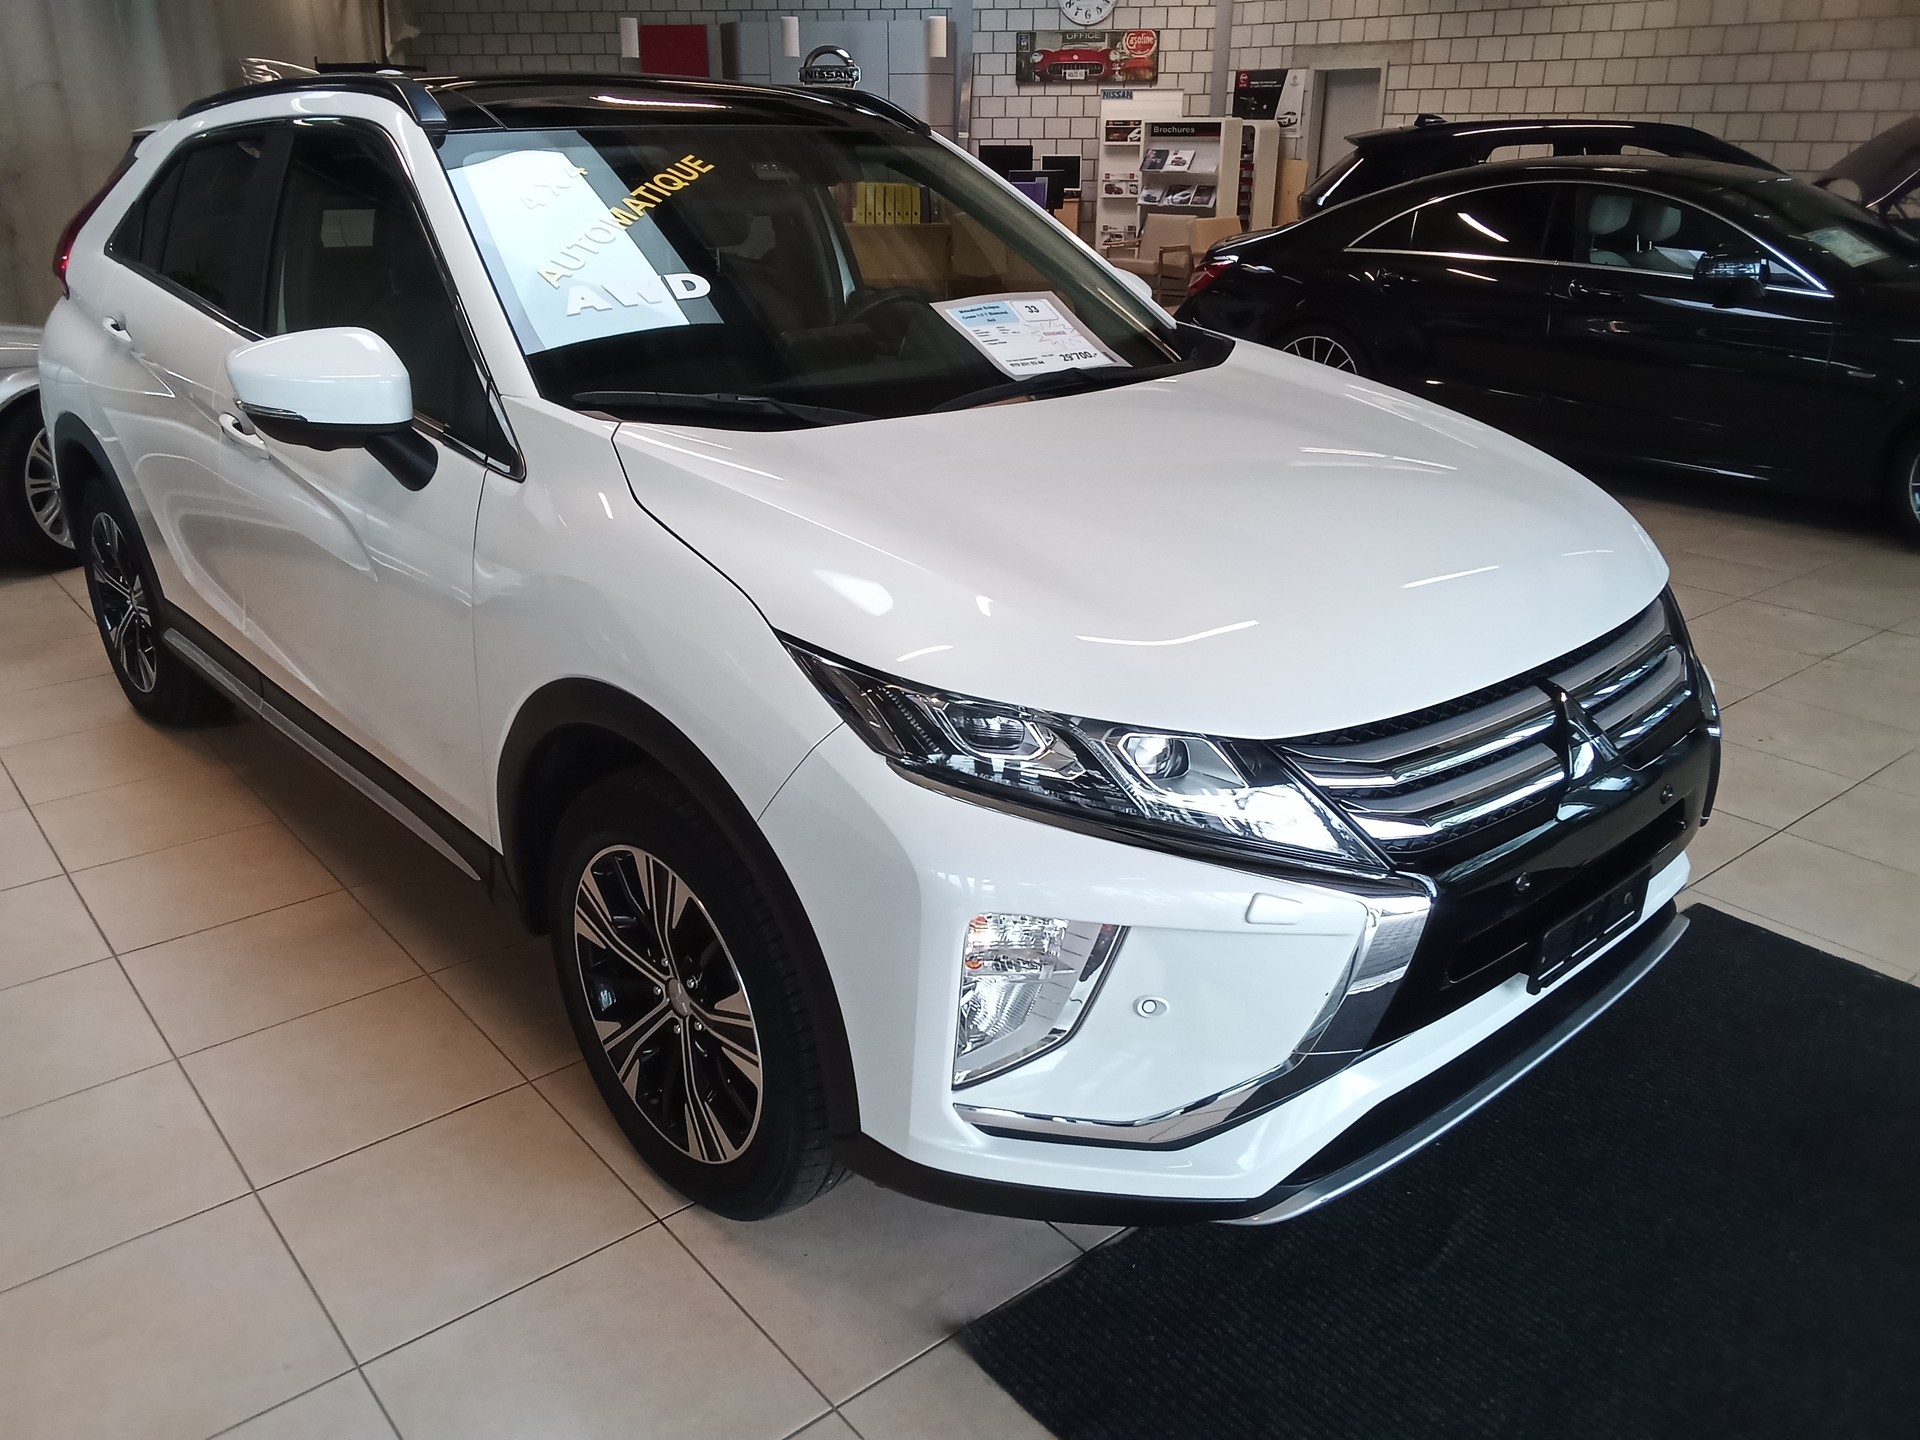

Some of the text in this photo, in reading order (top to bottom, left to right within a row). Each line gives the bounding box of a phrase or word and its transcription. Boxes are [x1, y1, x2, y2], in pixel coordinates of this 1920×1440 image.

[1084, 9, 1092, 19] 6
[1126, 32, 1154, 49] Gasoline
[804, 70, 853, 79] NISSAN
[1102, 90, 1133, 99] NISSAN
[1153, 125, 1196, 134] Brochures
[537, 154, 715, 289] AUTOMATIQUE
[566, 272, 712, 318] AWD
[1024, 305, 1040, 314] 33
[1059, 351, 1098, 362] 29'700.-
